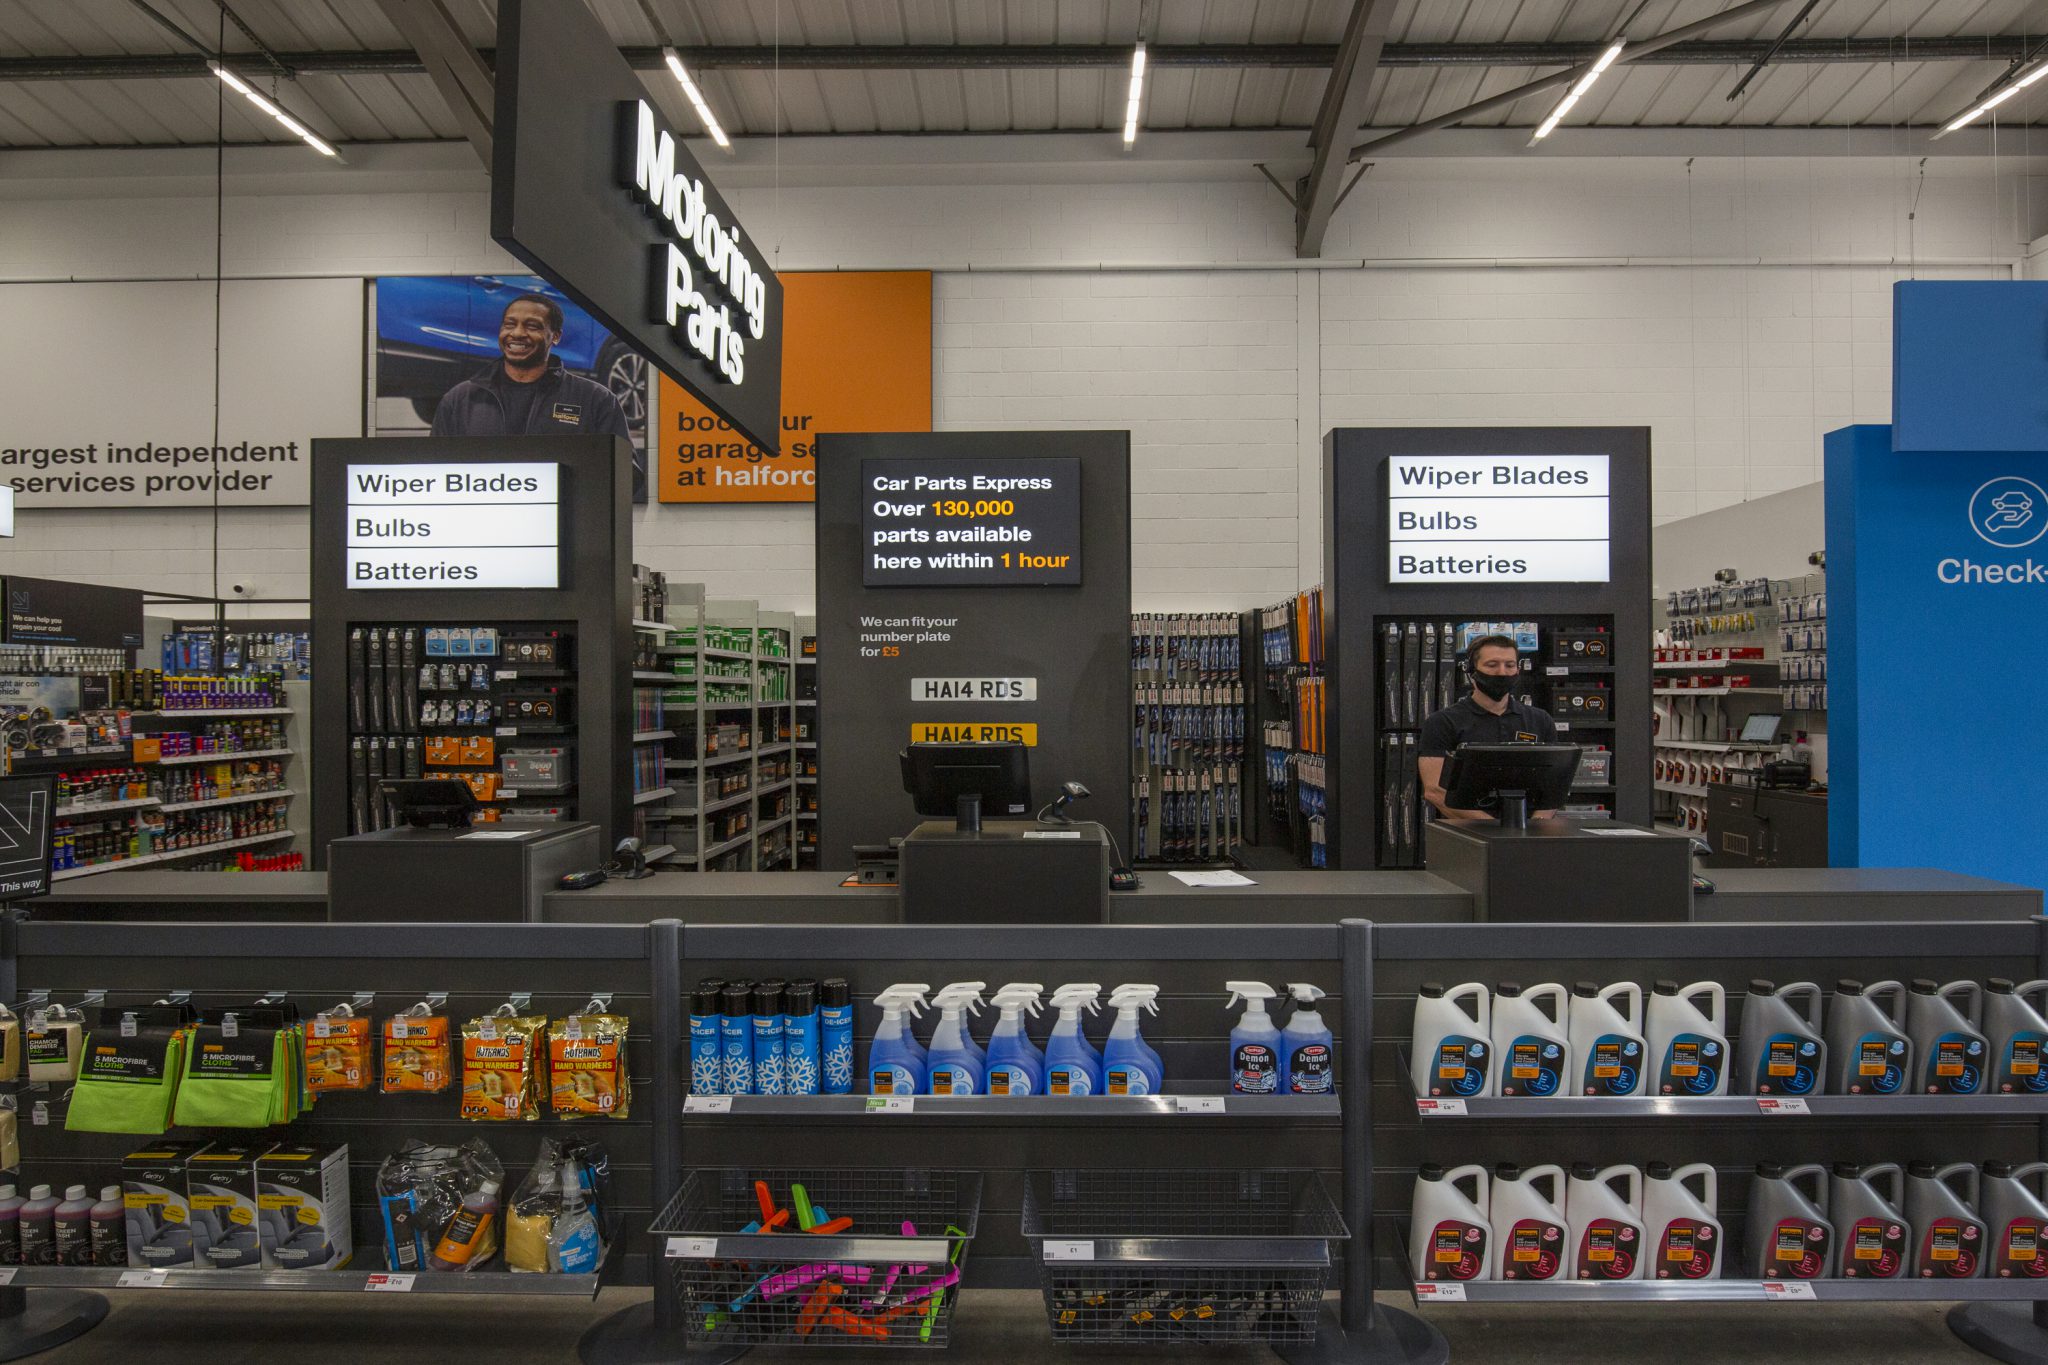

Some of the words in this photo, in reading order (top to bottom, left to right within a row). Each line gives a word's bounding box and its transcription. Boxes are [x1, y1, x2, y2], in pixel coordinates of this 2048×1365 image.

[636, 98, 766, 340] Motoring
[665, 242, 744, 386] Parts
[679, 412, 732, 431] boo
[782, 415, 812, 431] ur
[0, 444, 97, 469] argest
[107, 441, 299, 467] independent
[678, 443, 781, 463] garag
[677, 467, 706, 486] at
[715, 465, 815, 486] halford
[1399, 466, 1482, 489] Wiper
[1492, 465, 1589, 485] Blades
[9, 471, 136, 493] services
[145, 470, 273, 496] provider
[357, 474, 436, 497] Wiper
[445, 473, 538, 493] Blades
[873, 476, 909, 490] Car
[914, 475, 967, 490] Parts
[973, 475, 1052, 493] Express
[873, 501, 925, 517] Over
[932, 500, 1014, 519] 130,000
[356, 518, 431, 537] Bulbs
[1398, 511, 1478, 530] Bulbs
[873, 527, 930, 546] parts
[935, 526, 1032, 543] available
[873, 553, 922, 569] here
[928, 552, 993, 568] within
[1000, 553, 1010, 568] 1
[1019, 552, 1070, 568] hour
[1398, 555, 1527, 574] Batteries
[355, 561, 478, 580] Batteries
[37, 616, 50, 624] help
[860, 616, 882, 627] We
[884, 618, 909, 627] can
[911, 616, 925, 627] fit
[926, 618, 958, 629] your
[12, 624, 33, 632] regain
[860, 631, 914, 642] number
[916, 631, 951, 644] plate
[860, 646, 880, 657] for
[882, 647, 900, 657] £5
[980, 681, 1023, 698] RDS
[980, 727, 1023, 743] RDS
[0, 881, 20, 892] This
[22, 879, 41, 889] way
[307, 1038, 324, 1046] HAND
[102, 1056, 148, 1065] MICROFIBRE
[209, 1054, 256, 1062] MICROFIBRE
[1240, 1052, 1269, 1063] Demon
[1300, 1053, 1328, 1063] Demon
[485, 1061, 520, 1069] WARMERS
[554, 1062, 574, 1070] HAND
[575, 1061, 612, 1069] WARMERS
[1248, 1062, 1260, 1071] Ice
[1309, 1063, 1320, 1071] Ice
[346, 1069, 360, 1080] 10
[423, 1071, 435, 1082] 10
[504, 1096, 519, 1109] 10
[598, 1095, 613, 1108] 10
